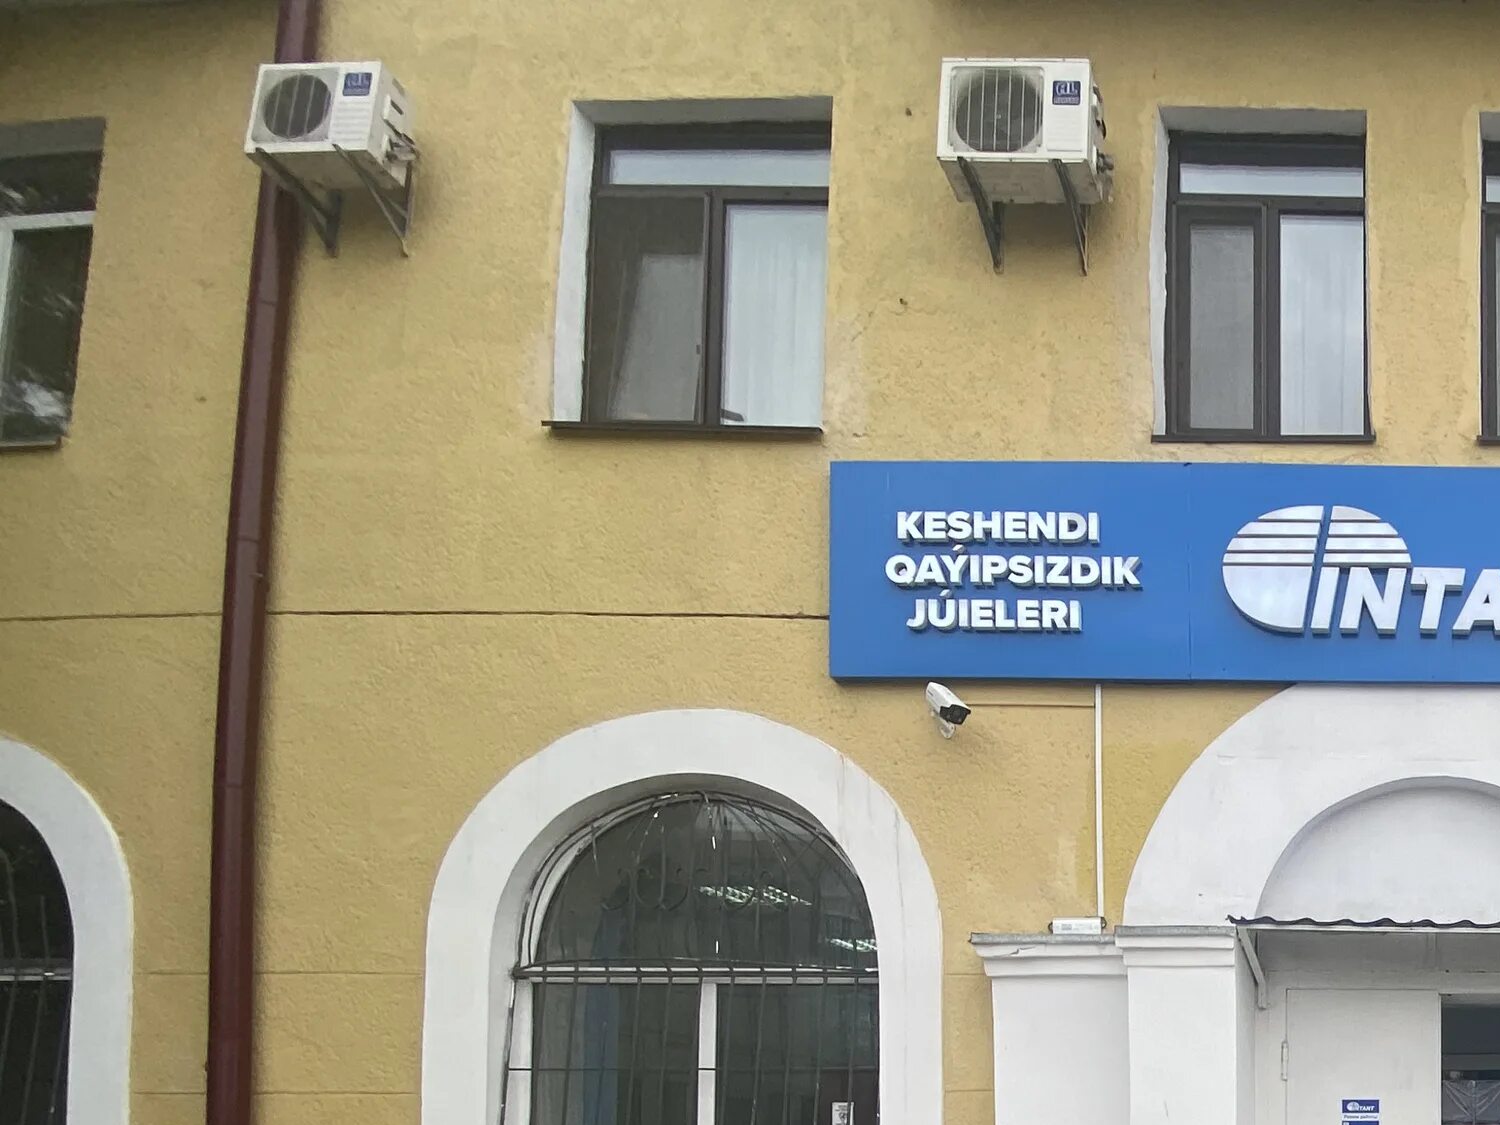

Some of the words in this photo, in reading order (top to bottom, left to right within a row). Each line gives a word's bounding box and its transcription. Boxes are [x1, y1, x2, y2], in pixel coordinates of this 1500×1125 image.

[896, 511, 1100, 544] KESHENDI
[885, 544, 1143, 590] QAÝIPSIZDIK
[906, 590, 1083, 633] JÚIELERI
